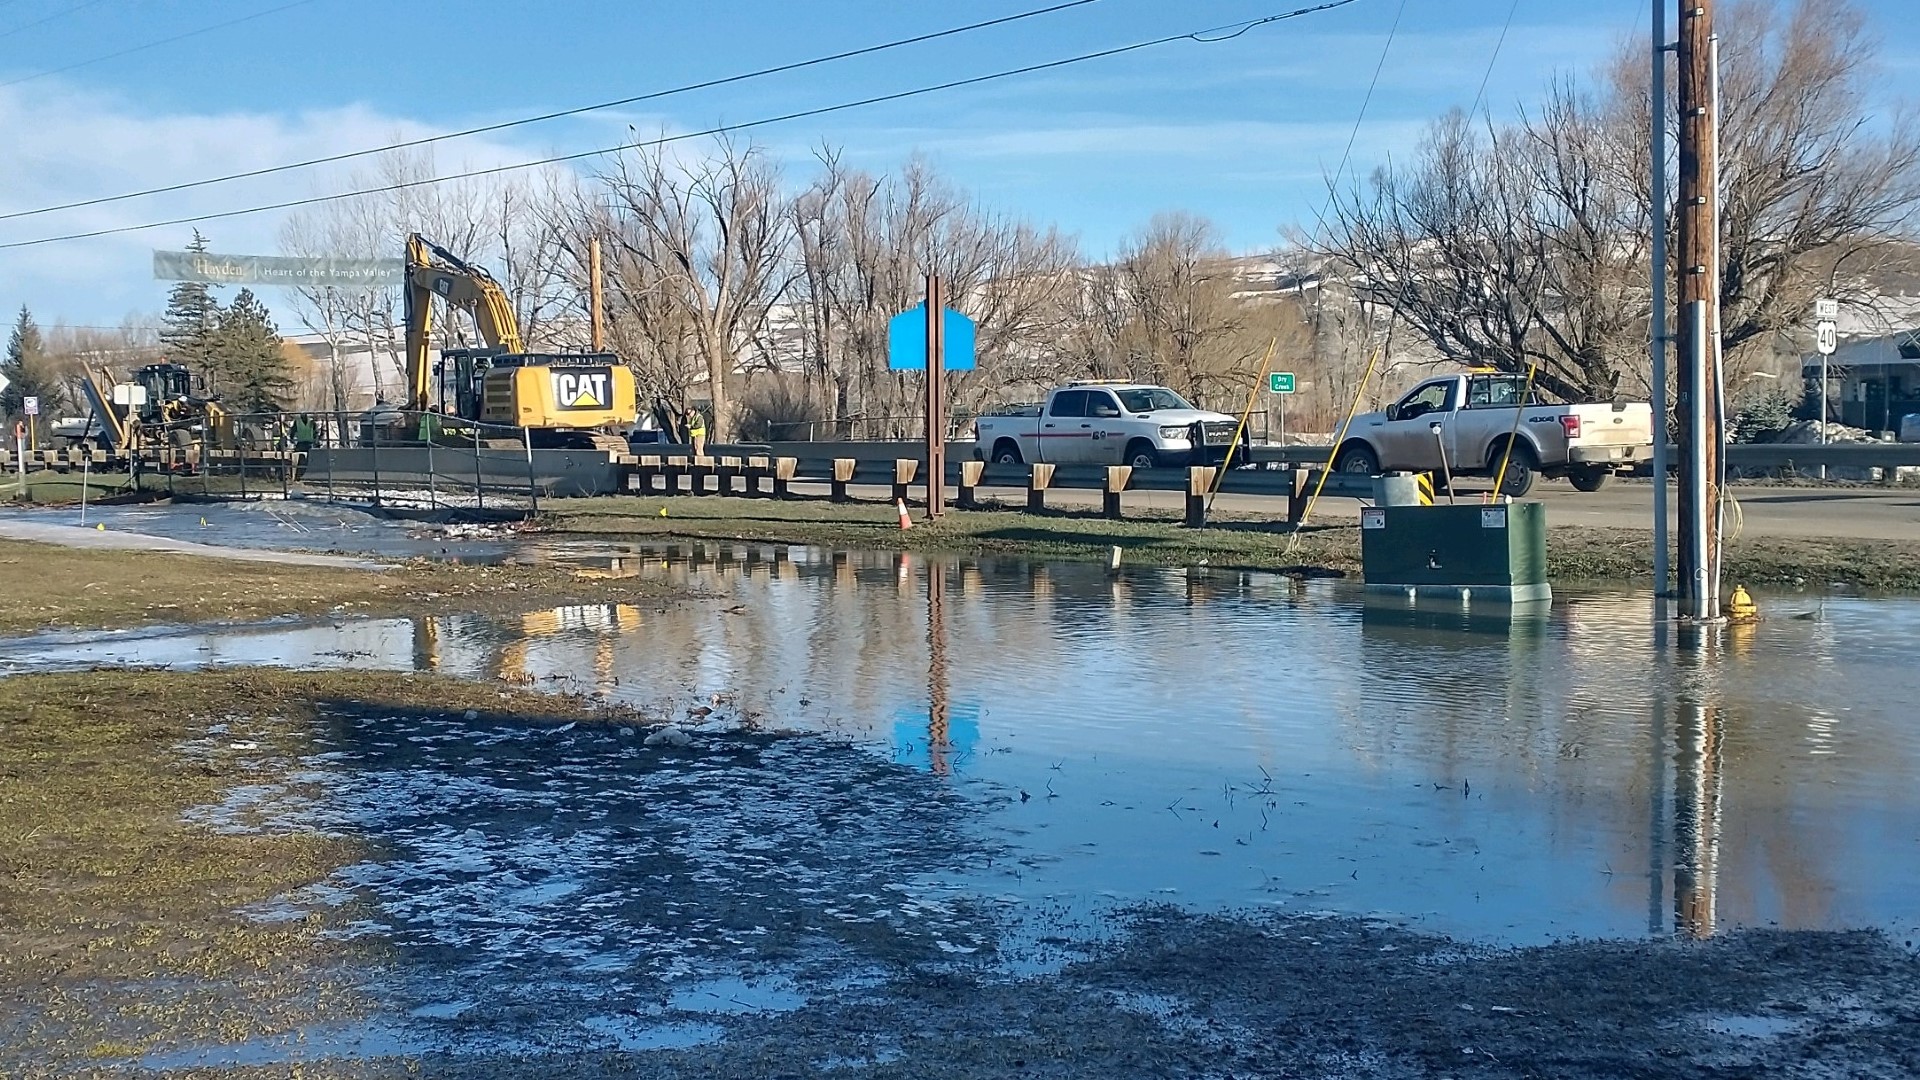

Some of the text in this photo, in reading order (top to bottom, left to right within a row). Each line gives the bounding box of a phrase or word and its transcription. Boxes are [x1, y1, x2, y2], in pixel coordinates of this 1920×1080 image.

[196, 258, 243, 279] Hayden
[264, 267, 292, 277] Heart
[297, 268, 306, 277] of
[310, 268, 326, 277] the
[328, 268, 361, 279] Yampa
[1819, 303, 1836, 314] WEST
[1820, 329, 1834, 348] 40
[559, 373, 606, 406] CAT
